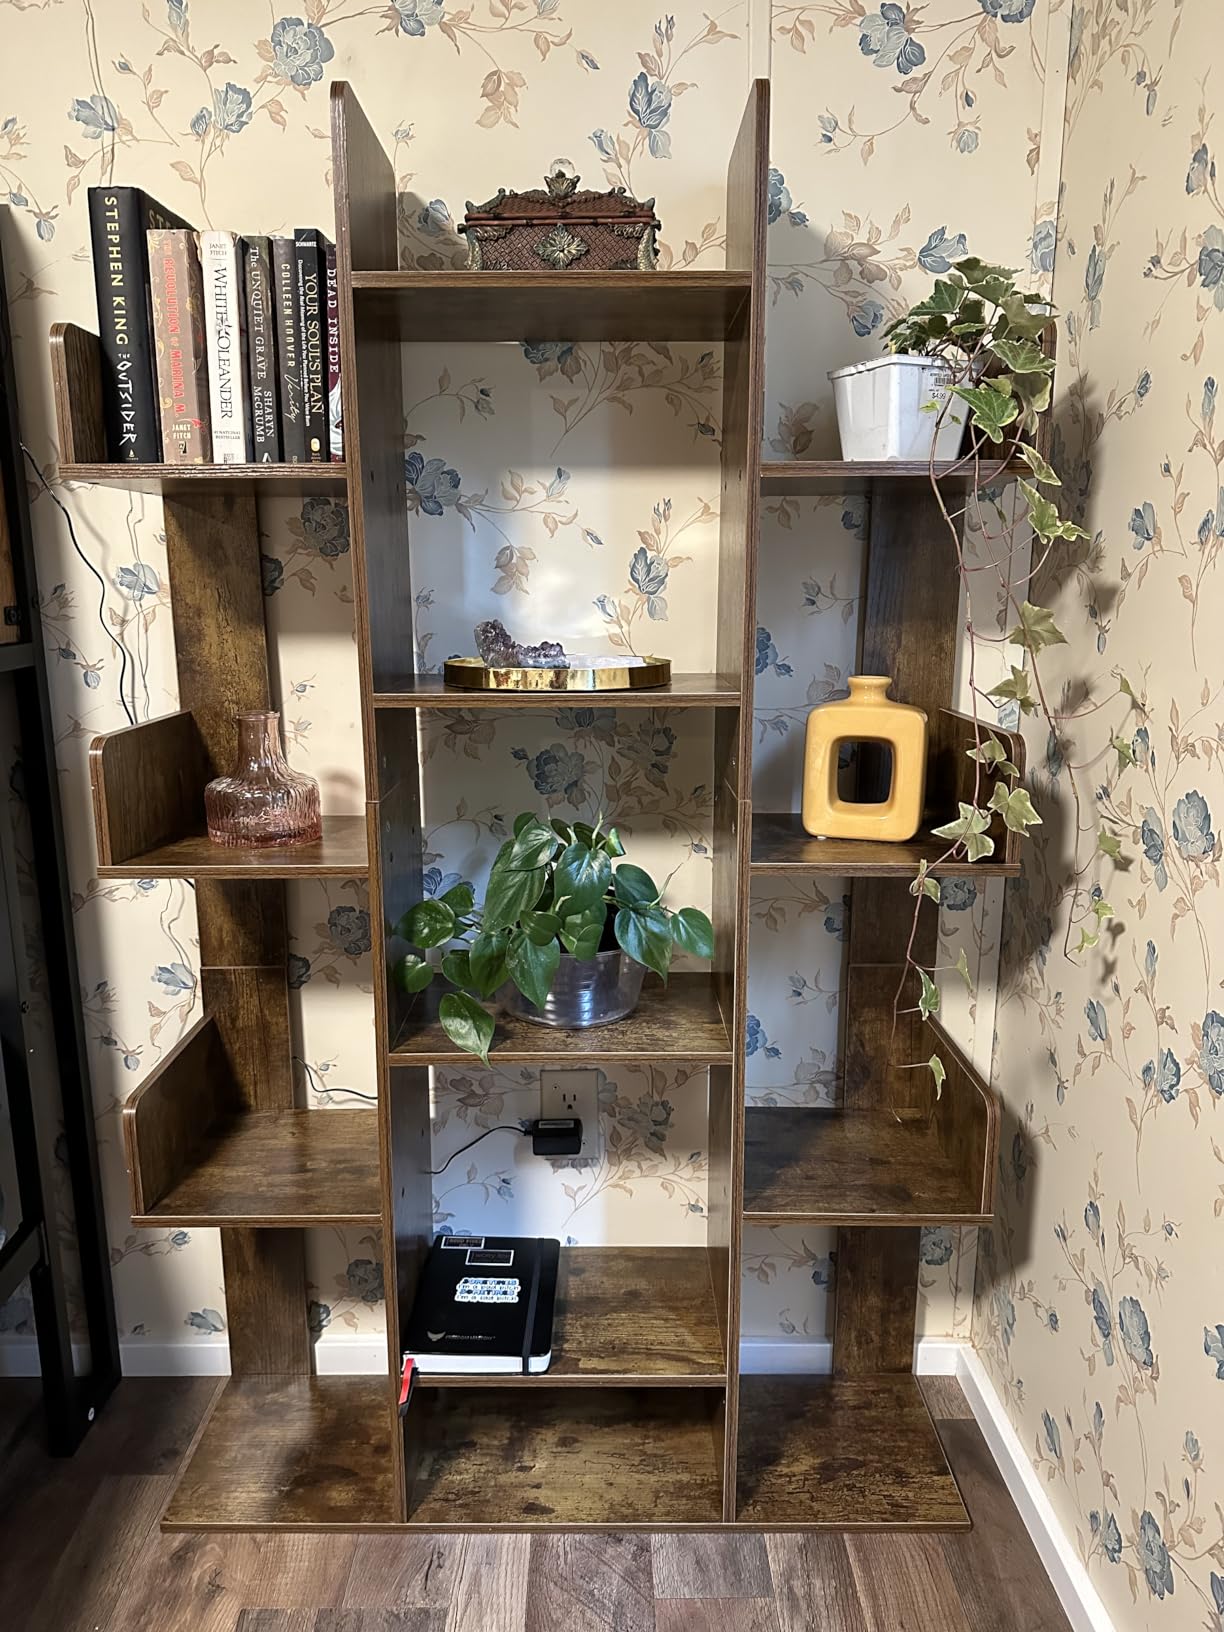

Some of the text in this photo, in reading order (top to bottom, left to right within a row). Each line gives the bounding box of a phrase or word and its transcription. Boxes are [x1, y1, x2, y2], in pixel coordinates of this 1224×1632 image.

[104, 196, 129, 345] STEPHEN KING
[164, 257, 180, 333] REVOLUTION
[250, 246, 267, 380] The UNQUIET GRAVE
[214, 266, 233, 419] WHITE OLEANDER
[281, 263, 301, 423] COLLEEN HOOVER Verity
[305, 273, 323, 414] YOUR SOUL'S PLAN
[327, 269, 339, 373] DEAD INSIDE
[117, 360, 137, 446] OUTSIDER
[170, 349, 185, 399] MARINA
[175, 403, 186, 417] M.
[253, 386, 265, 443] McCRUMB
[264, 390, 275, 438] SHARYN
[173, 432, 191, 440] FITCH
